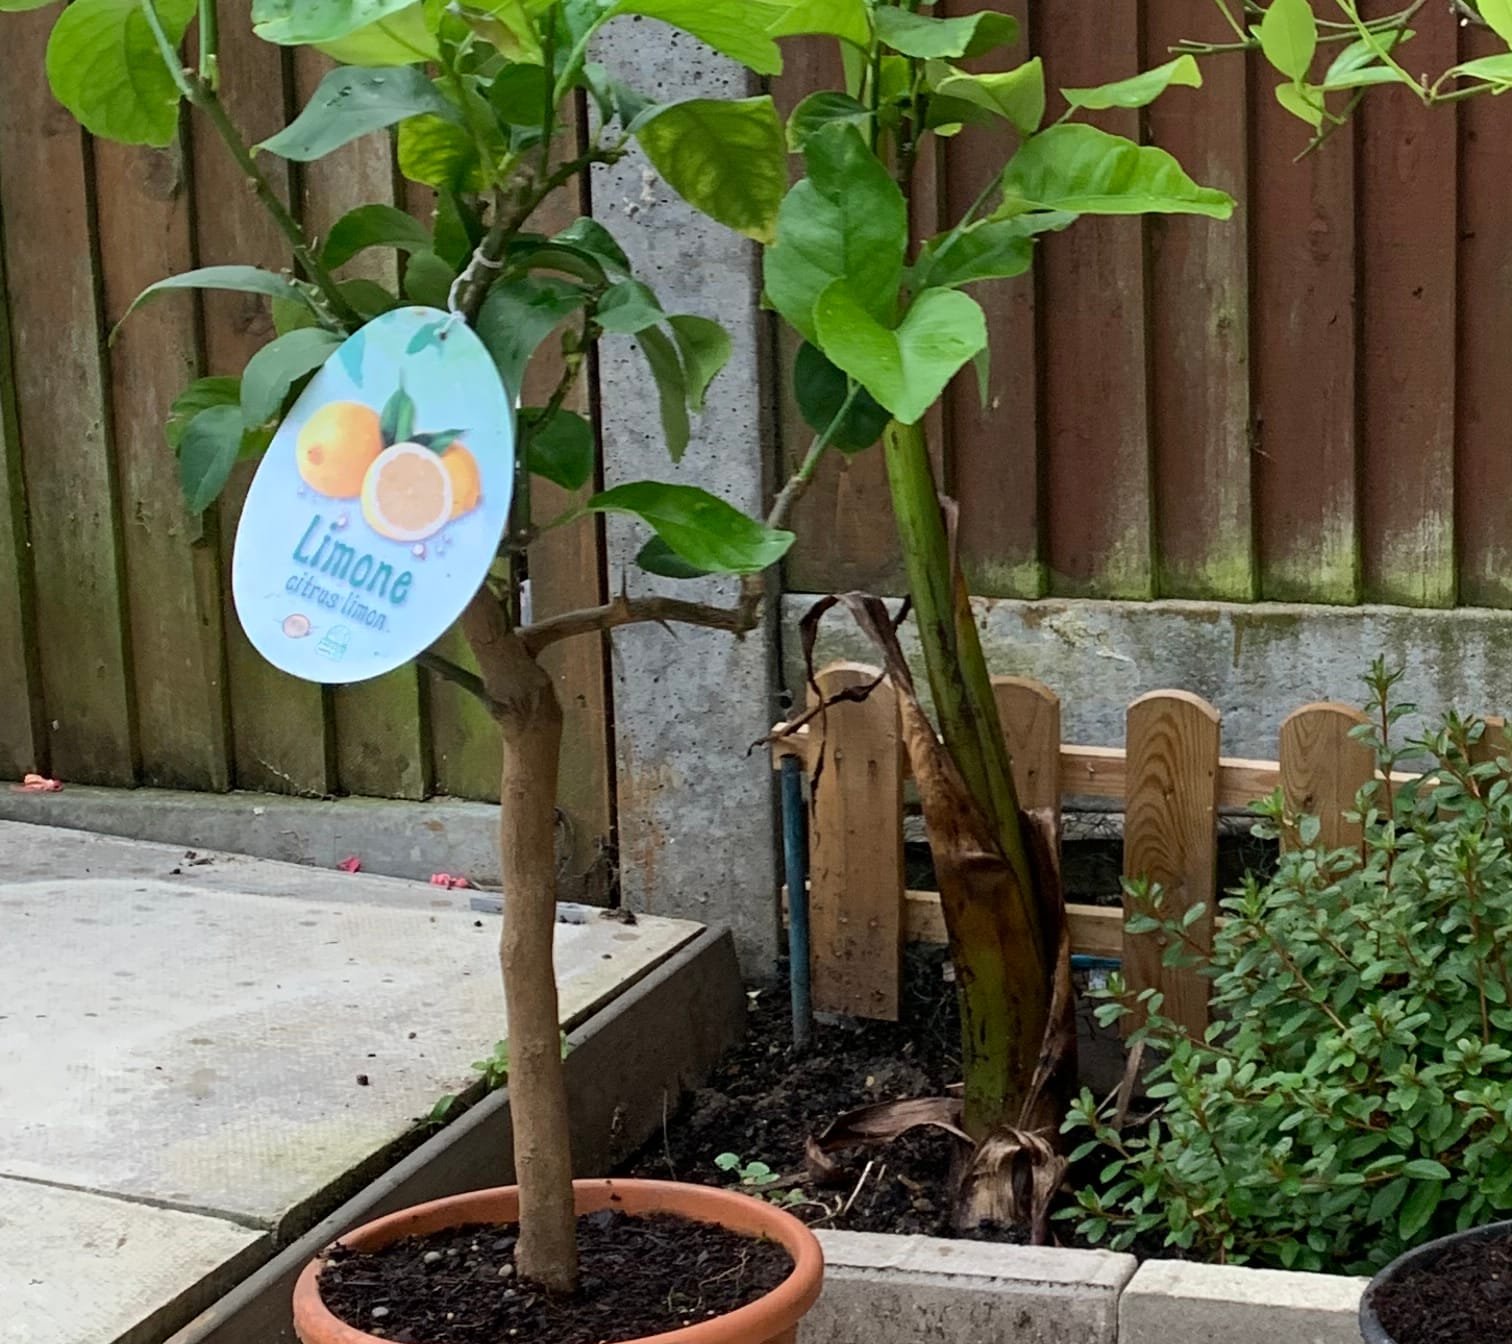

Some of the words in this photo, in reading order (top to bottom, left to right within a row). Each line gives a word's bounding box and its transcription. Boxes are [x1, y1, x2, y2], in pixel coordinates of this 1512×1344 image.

[293, 514, 412, 604] Limone
[285, 572, 340, 609] citrus
[340, 591, 387, 631] limon
